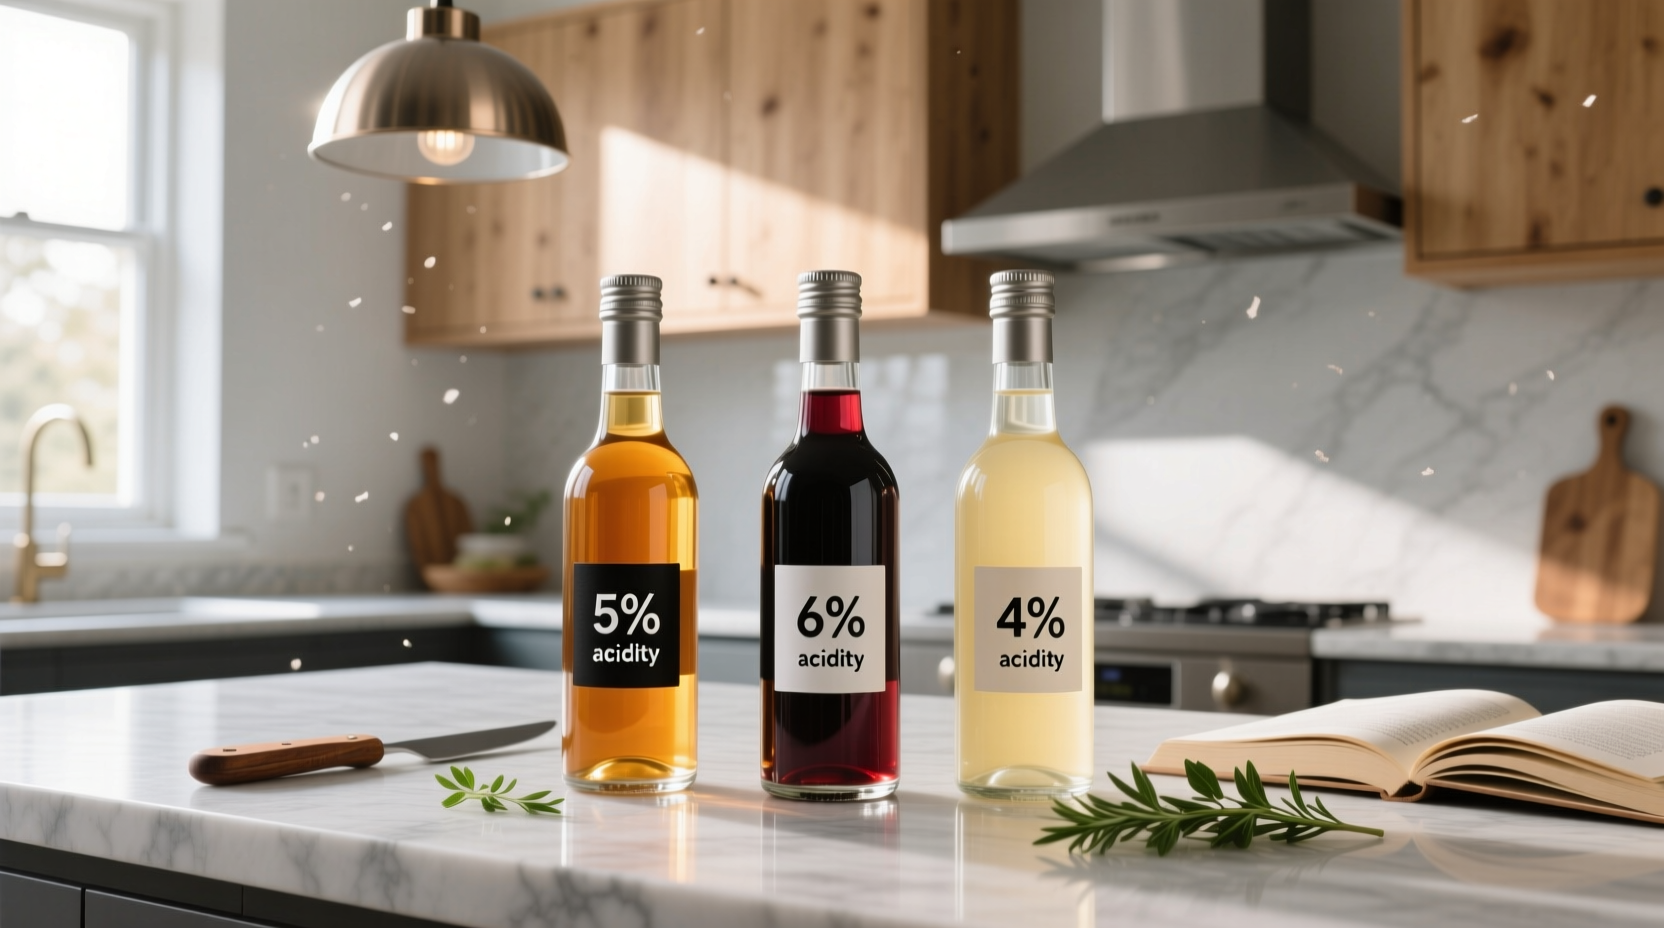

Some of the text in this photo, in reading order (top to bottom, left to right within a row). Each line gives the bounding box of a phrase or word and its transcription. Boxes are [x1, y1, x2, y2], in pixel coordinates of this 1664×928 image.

[593, 593, 661, 636] 5%
[796, 595, 866, 639] 6%
[996, 596, 1065, 639] 4%
[592, 642, 660, 668] acidity
[798, 648, 865, 673] acidity
[999, 649, 1065, 673] acidity
